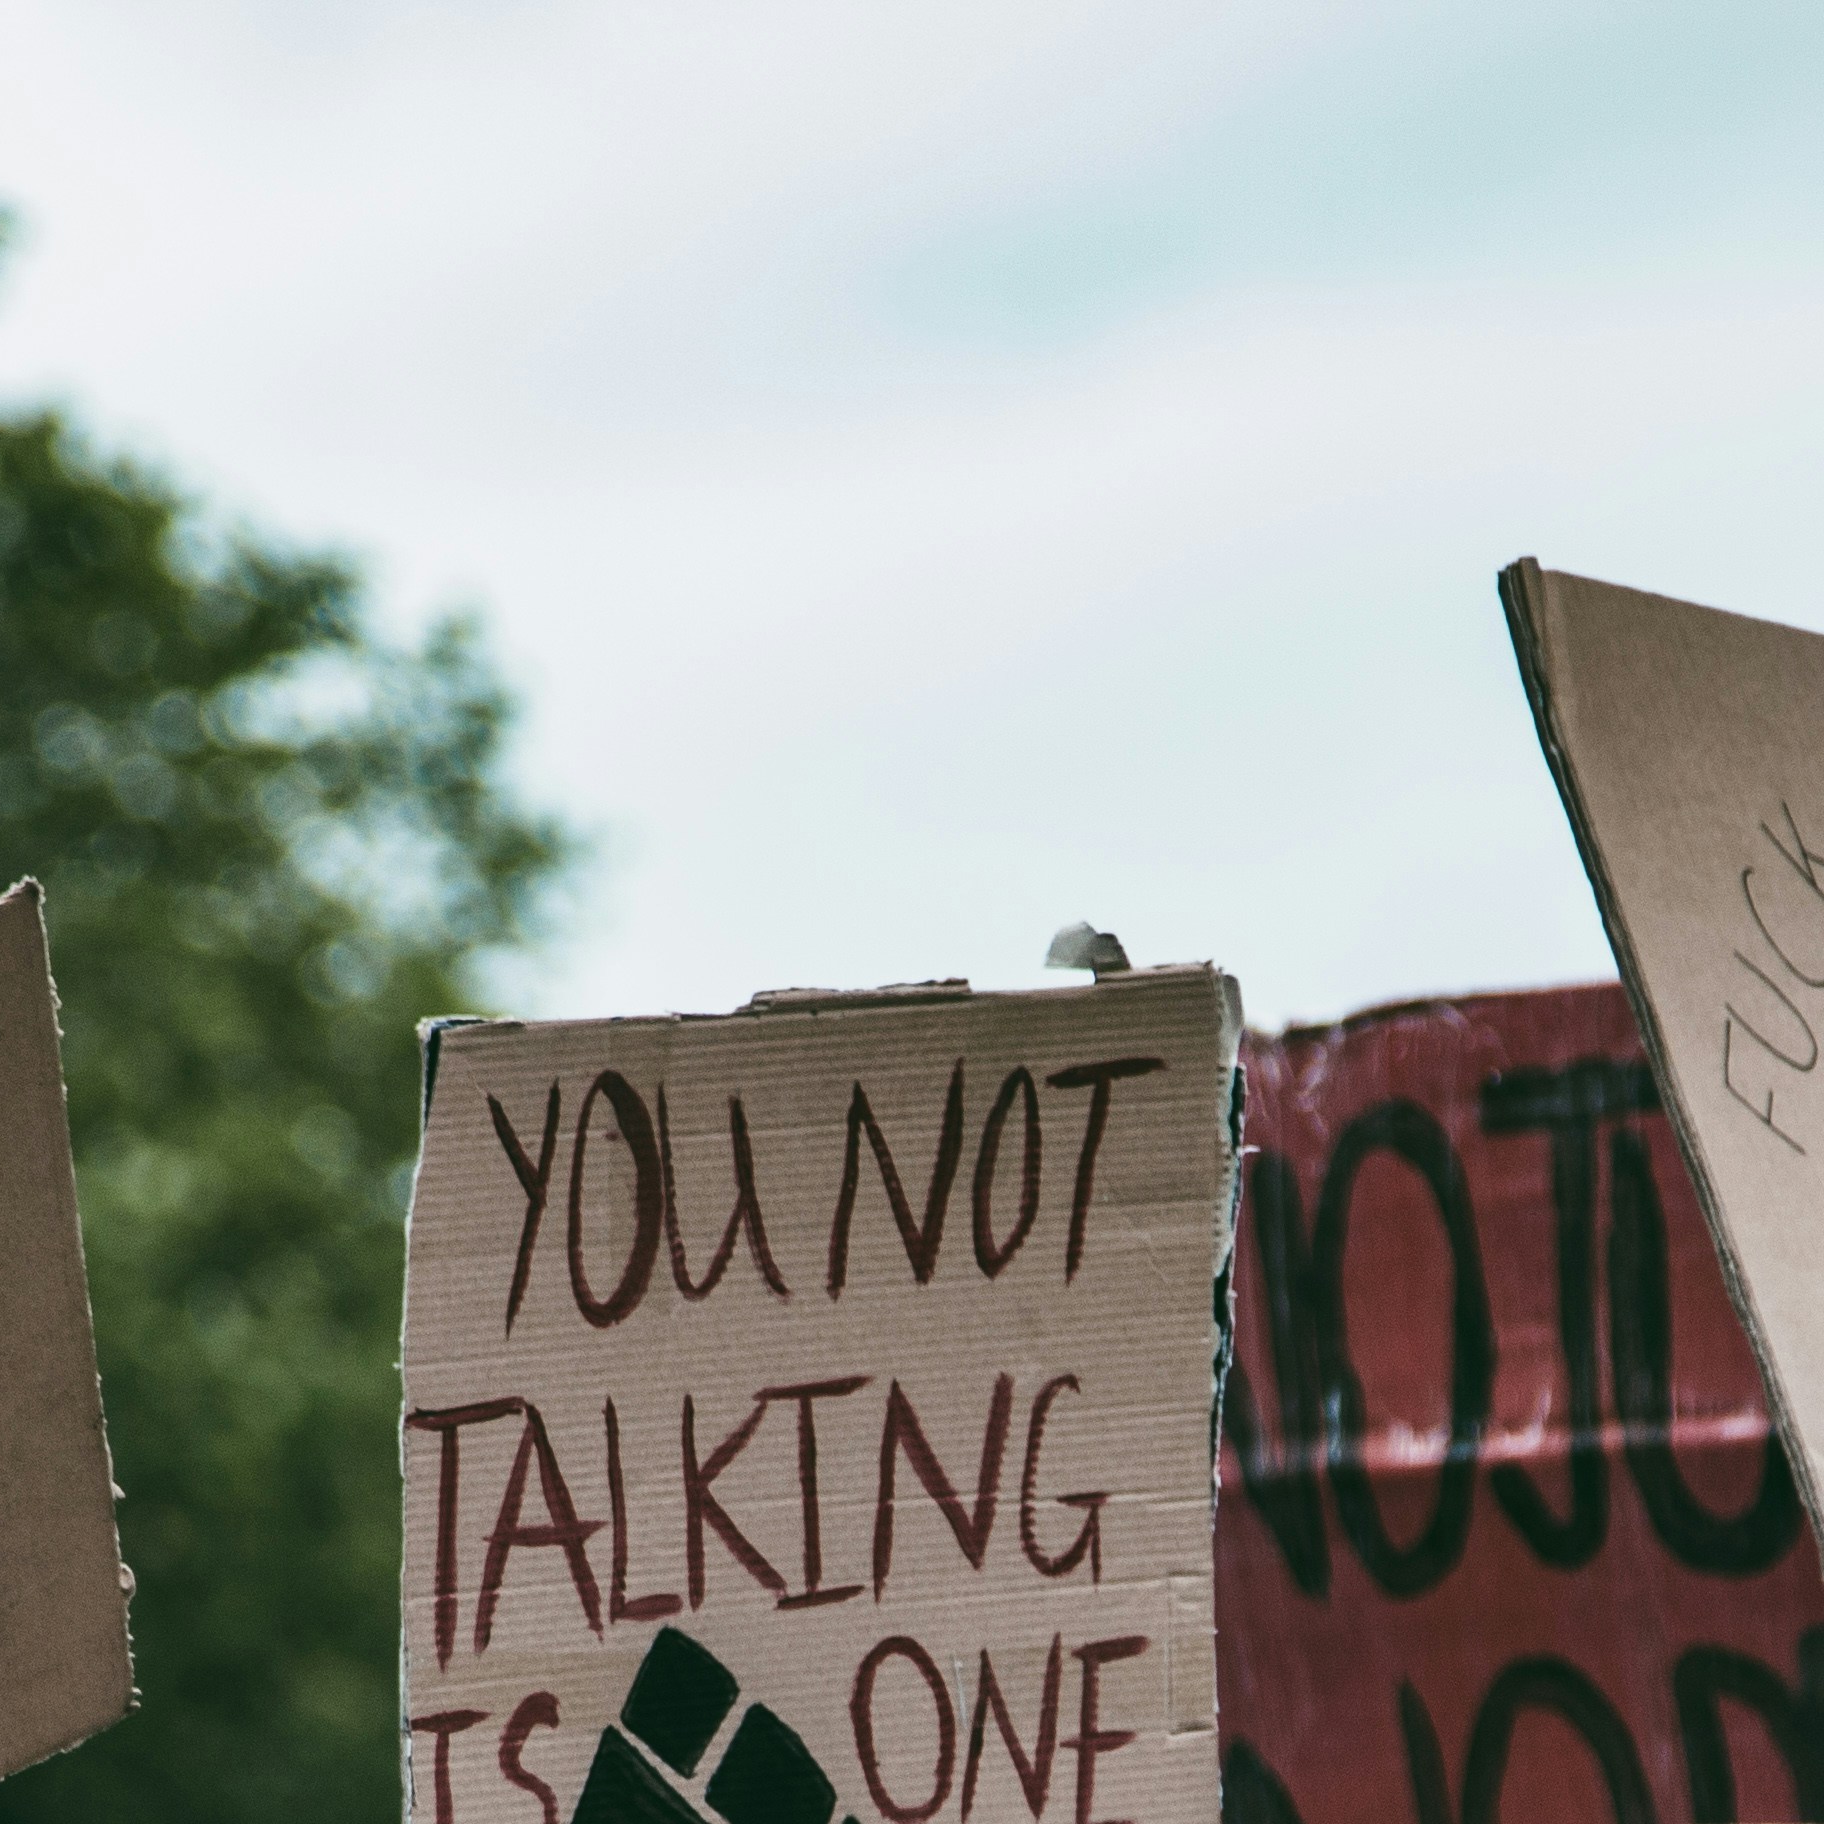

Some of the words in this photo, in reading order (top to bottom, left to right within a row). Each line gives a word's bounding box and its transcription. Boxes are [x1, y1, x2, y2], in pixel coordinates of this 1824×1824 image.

[487, 1069, 791, 1339] YOU
[826, 1058, 1166, 1301] NOT
[405, 1372, 1111, 1673] TALKING
